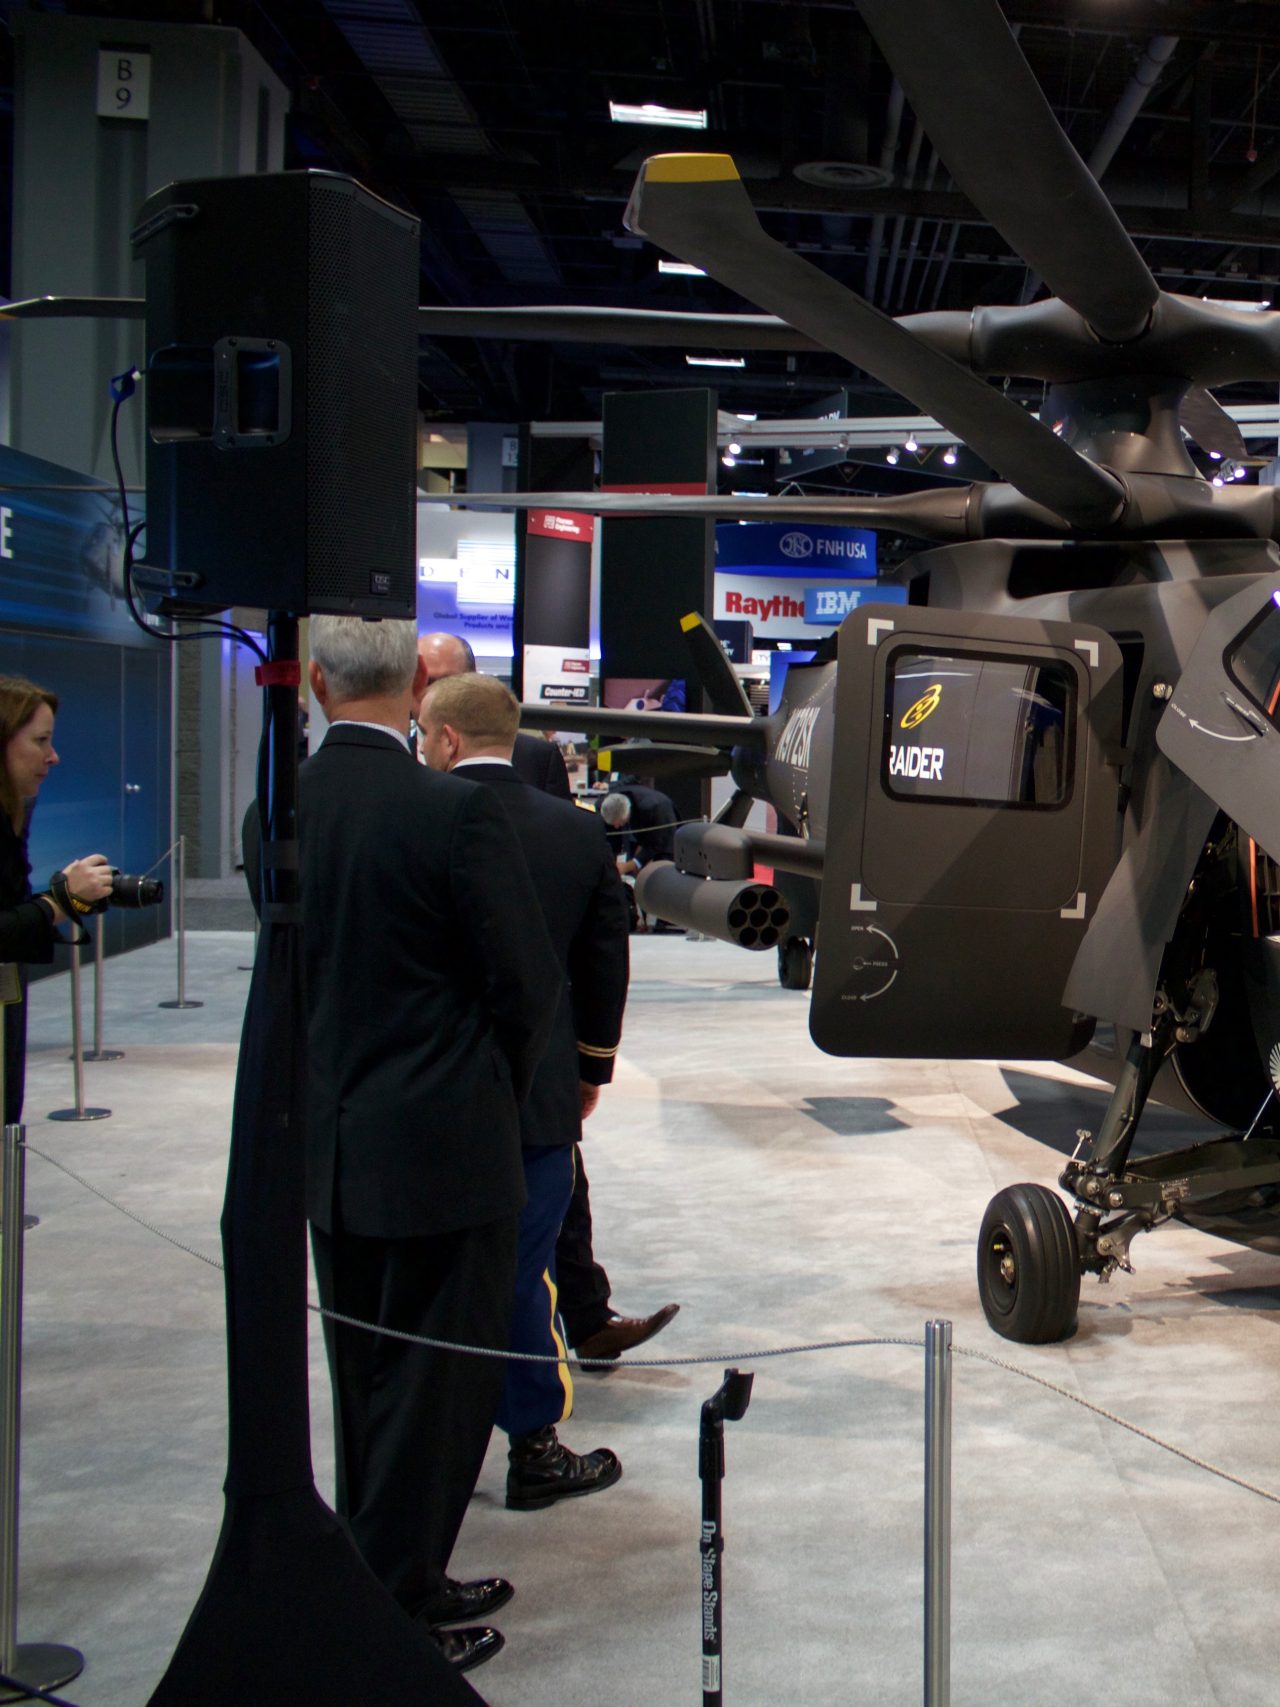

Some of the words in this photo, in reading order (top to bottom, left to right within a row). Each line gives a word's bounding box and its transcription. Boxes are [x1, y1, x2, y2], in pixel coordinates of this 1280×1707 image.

[117, 59, 132, 80] B
[116, 87, 131, 109] 9
[816, 539, 844, 557] FNH
[846, 541, 867, 559] USA
[725, 591, 805, 622] Rayth
[816, 591, 861, 615] IBM
[459, 613, 489, 622] Supplier
[464, 622, 494, 630] Products
[703, 1590, 719, 1641] Stands
